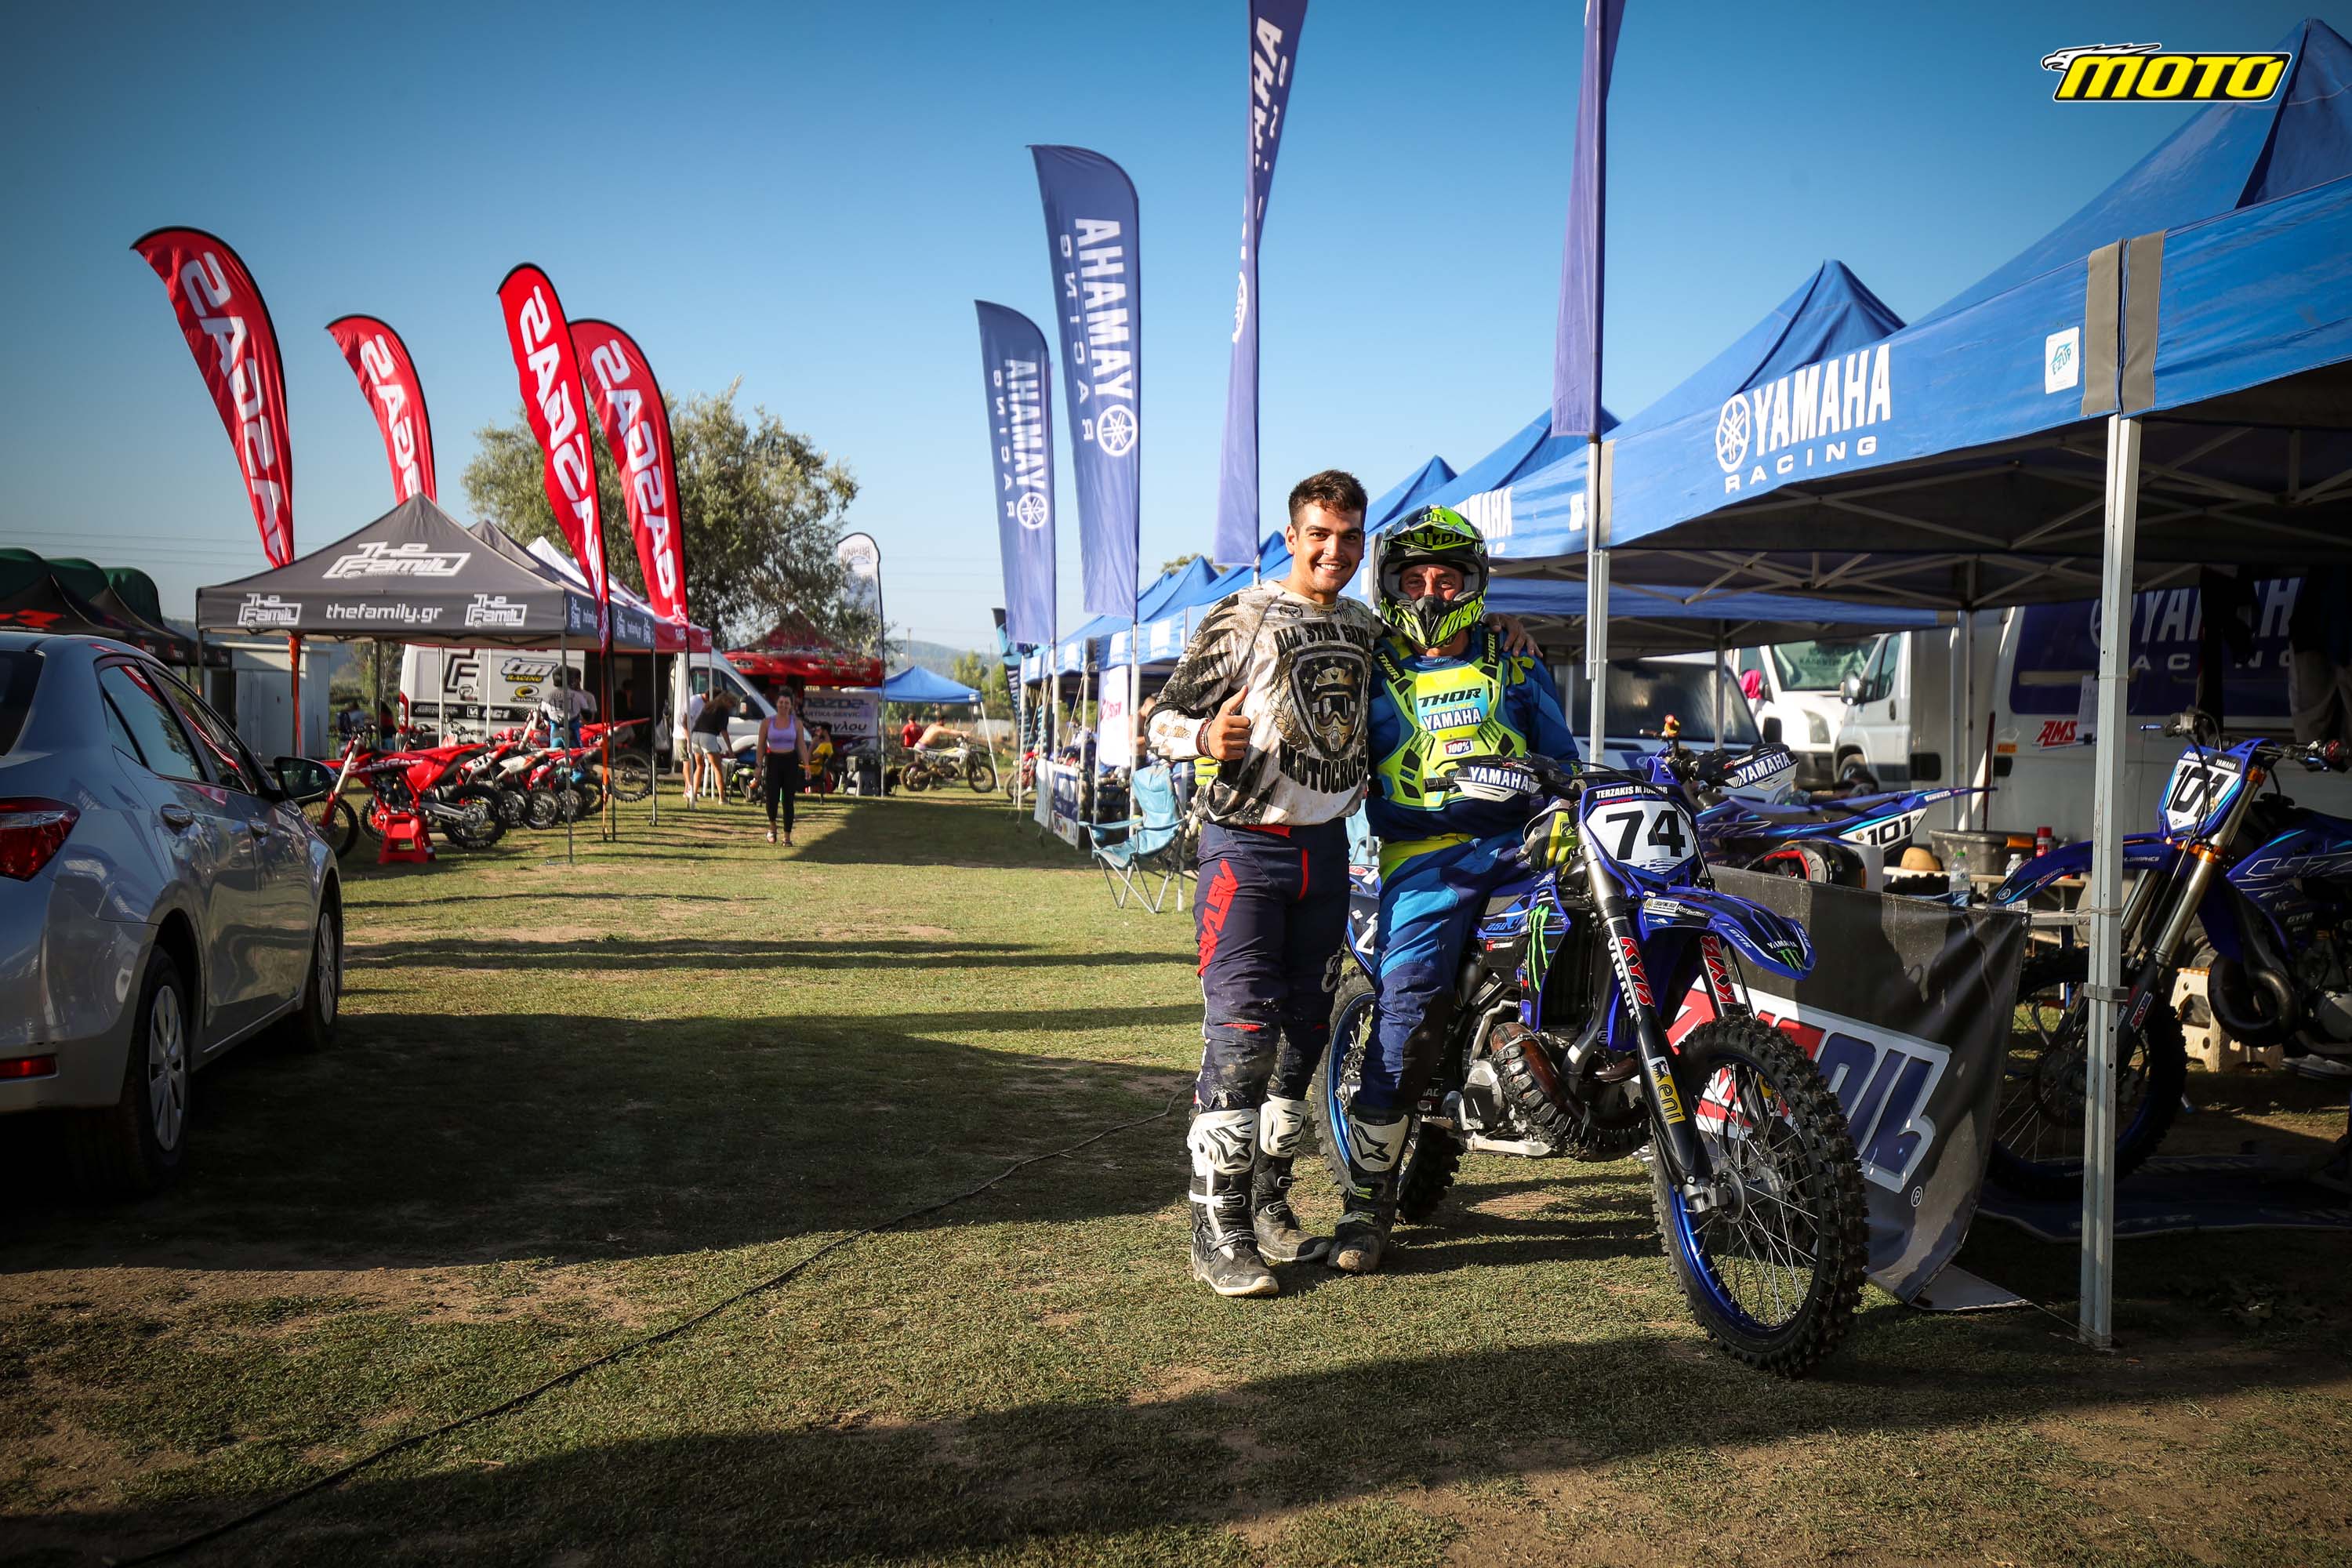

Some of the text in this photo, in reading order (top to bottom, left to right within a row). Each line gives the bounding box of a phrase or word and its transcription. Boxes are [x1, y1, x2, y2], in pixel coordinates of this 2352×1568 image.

[1753, 343, 1891, 457] YAMAHA
[1725, 436, 1877, 494] RACING
[326, 603, 443, 623] thefamily.gr
[1273, 627, 1303, 657] ALL
[1487, 633, 1496, 663] THOR
[1377, 653, 1401, 681] THOR
[1417, 688, 1482, 708] THOR
[1422, 708, 1482, 731] YAMAHA
[2037, 720, 2078, 747] AMS
[1447, 741, 1470, 753] 100%
[1279, 738, 1367, 793] MOTOCROS
[1470, 766, 1530, 792] YAMAHA
[1737, 752, 1791, 784] YAMAHA
[2215, 758, 2237, 771] YAMAHA
[1595, 786, 1634, 799] TERZAKIS
[1606, 809, 1686, 861] 74
[1867, 815, 1911, 846] 101
[1766, 940, 1799, 949] YAMAHA
[1620, 936, 1656, 1007] KYB
[1700, 935, 1738, 1004] KYB
[1657, 1083, 1686, 1124] eni
